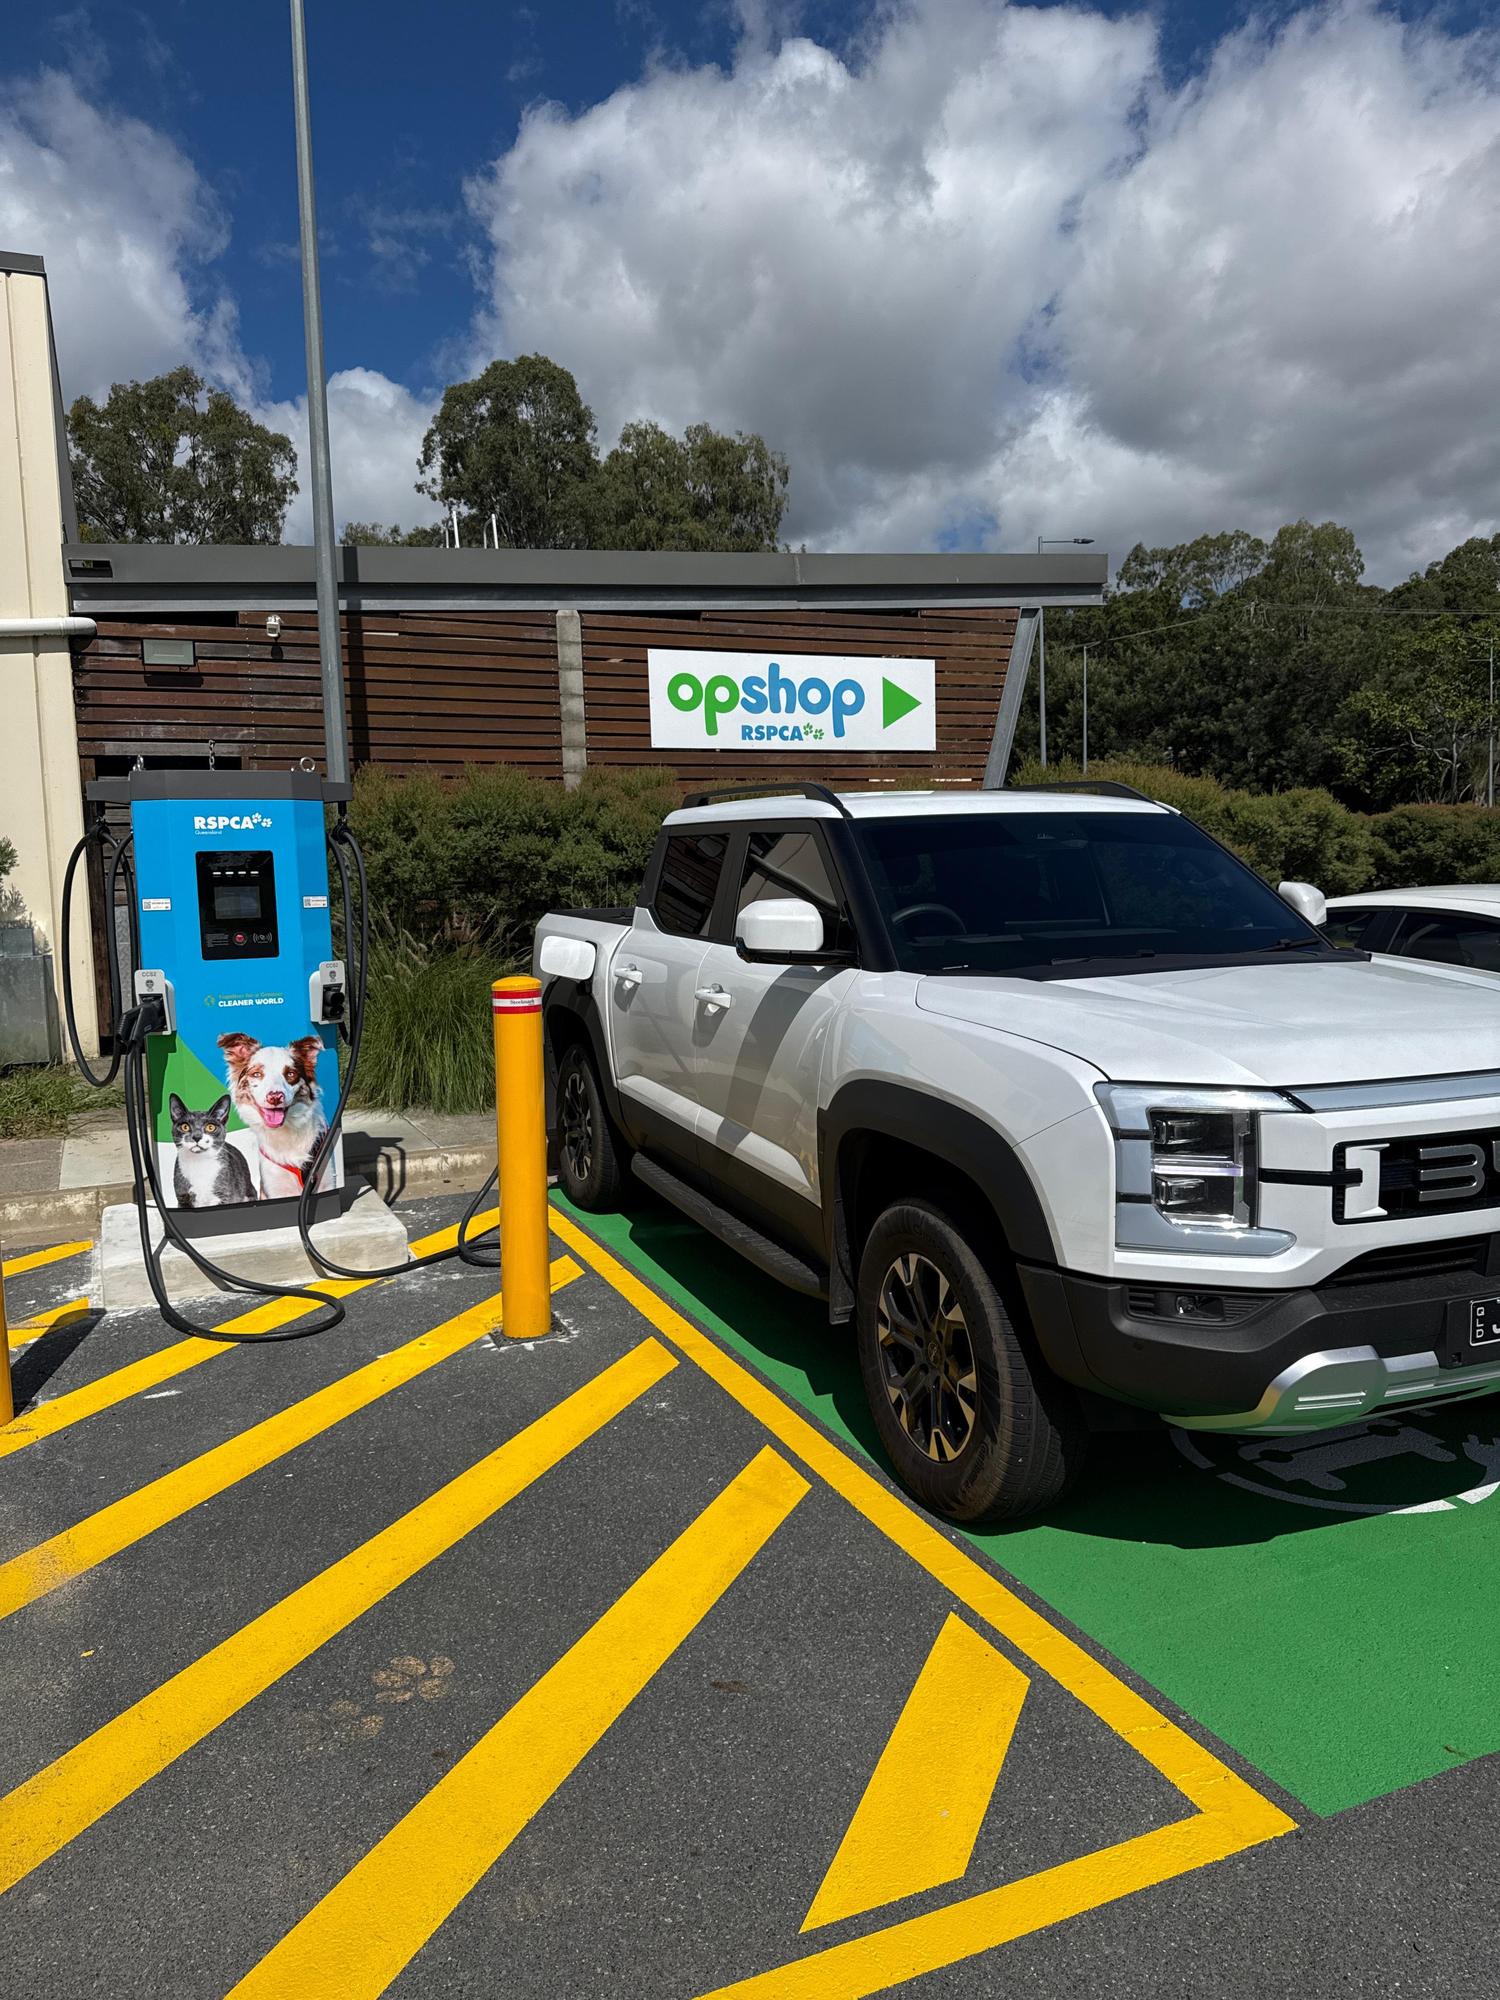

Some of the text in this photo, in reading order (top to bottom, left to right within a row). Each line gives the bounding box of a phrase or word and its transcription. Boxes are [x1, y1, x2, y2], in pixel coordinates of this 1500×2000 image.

[667, 662, 865, 738] opshop
[741, 724, 803, 741] RSPCA
[193, 815, 254, 830] RSPCA
[218, 997, 284, 1007] CLEANER WORLD
